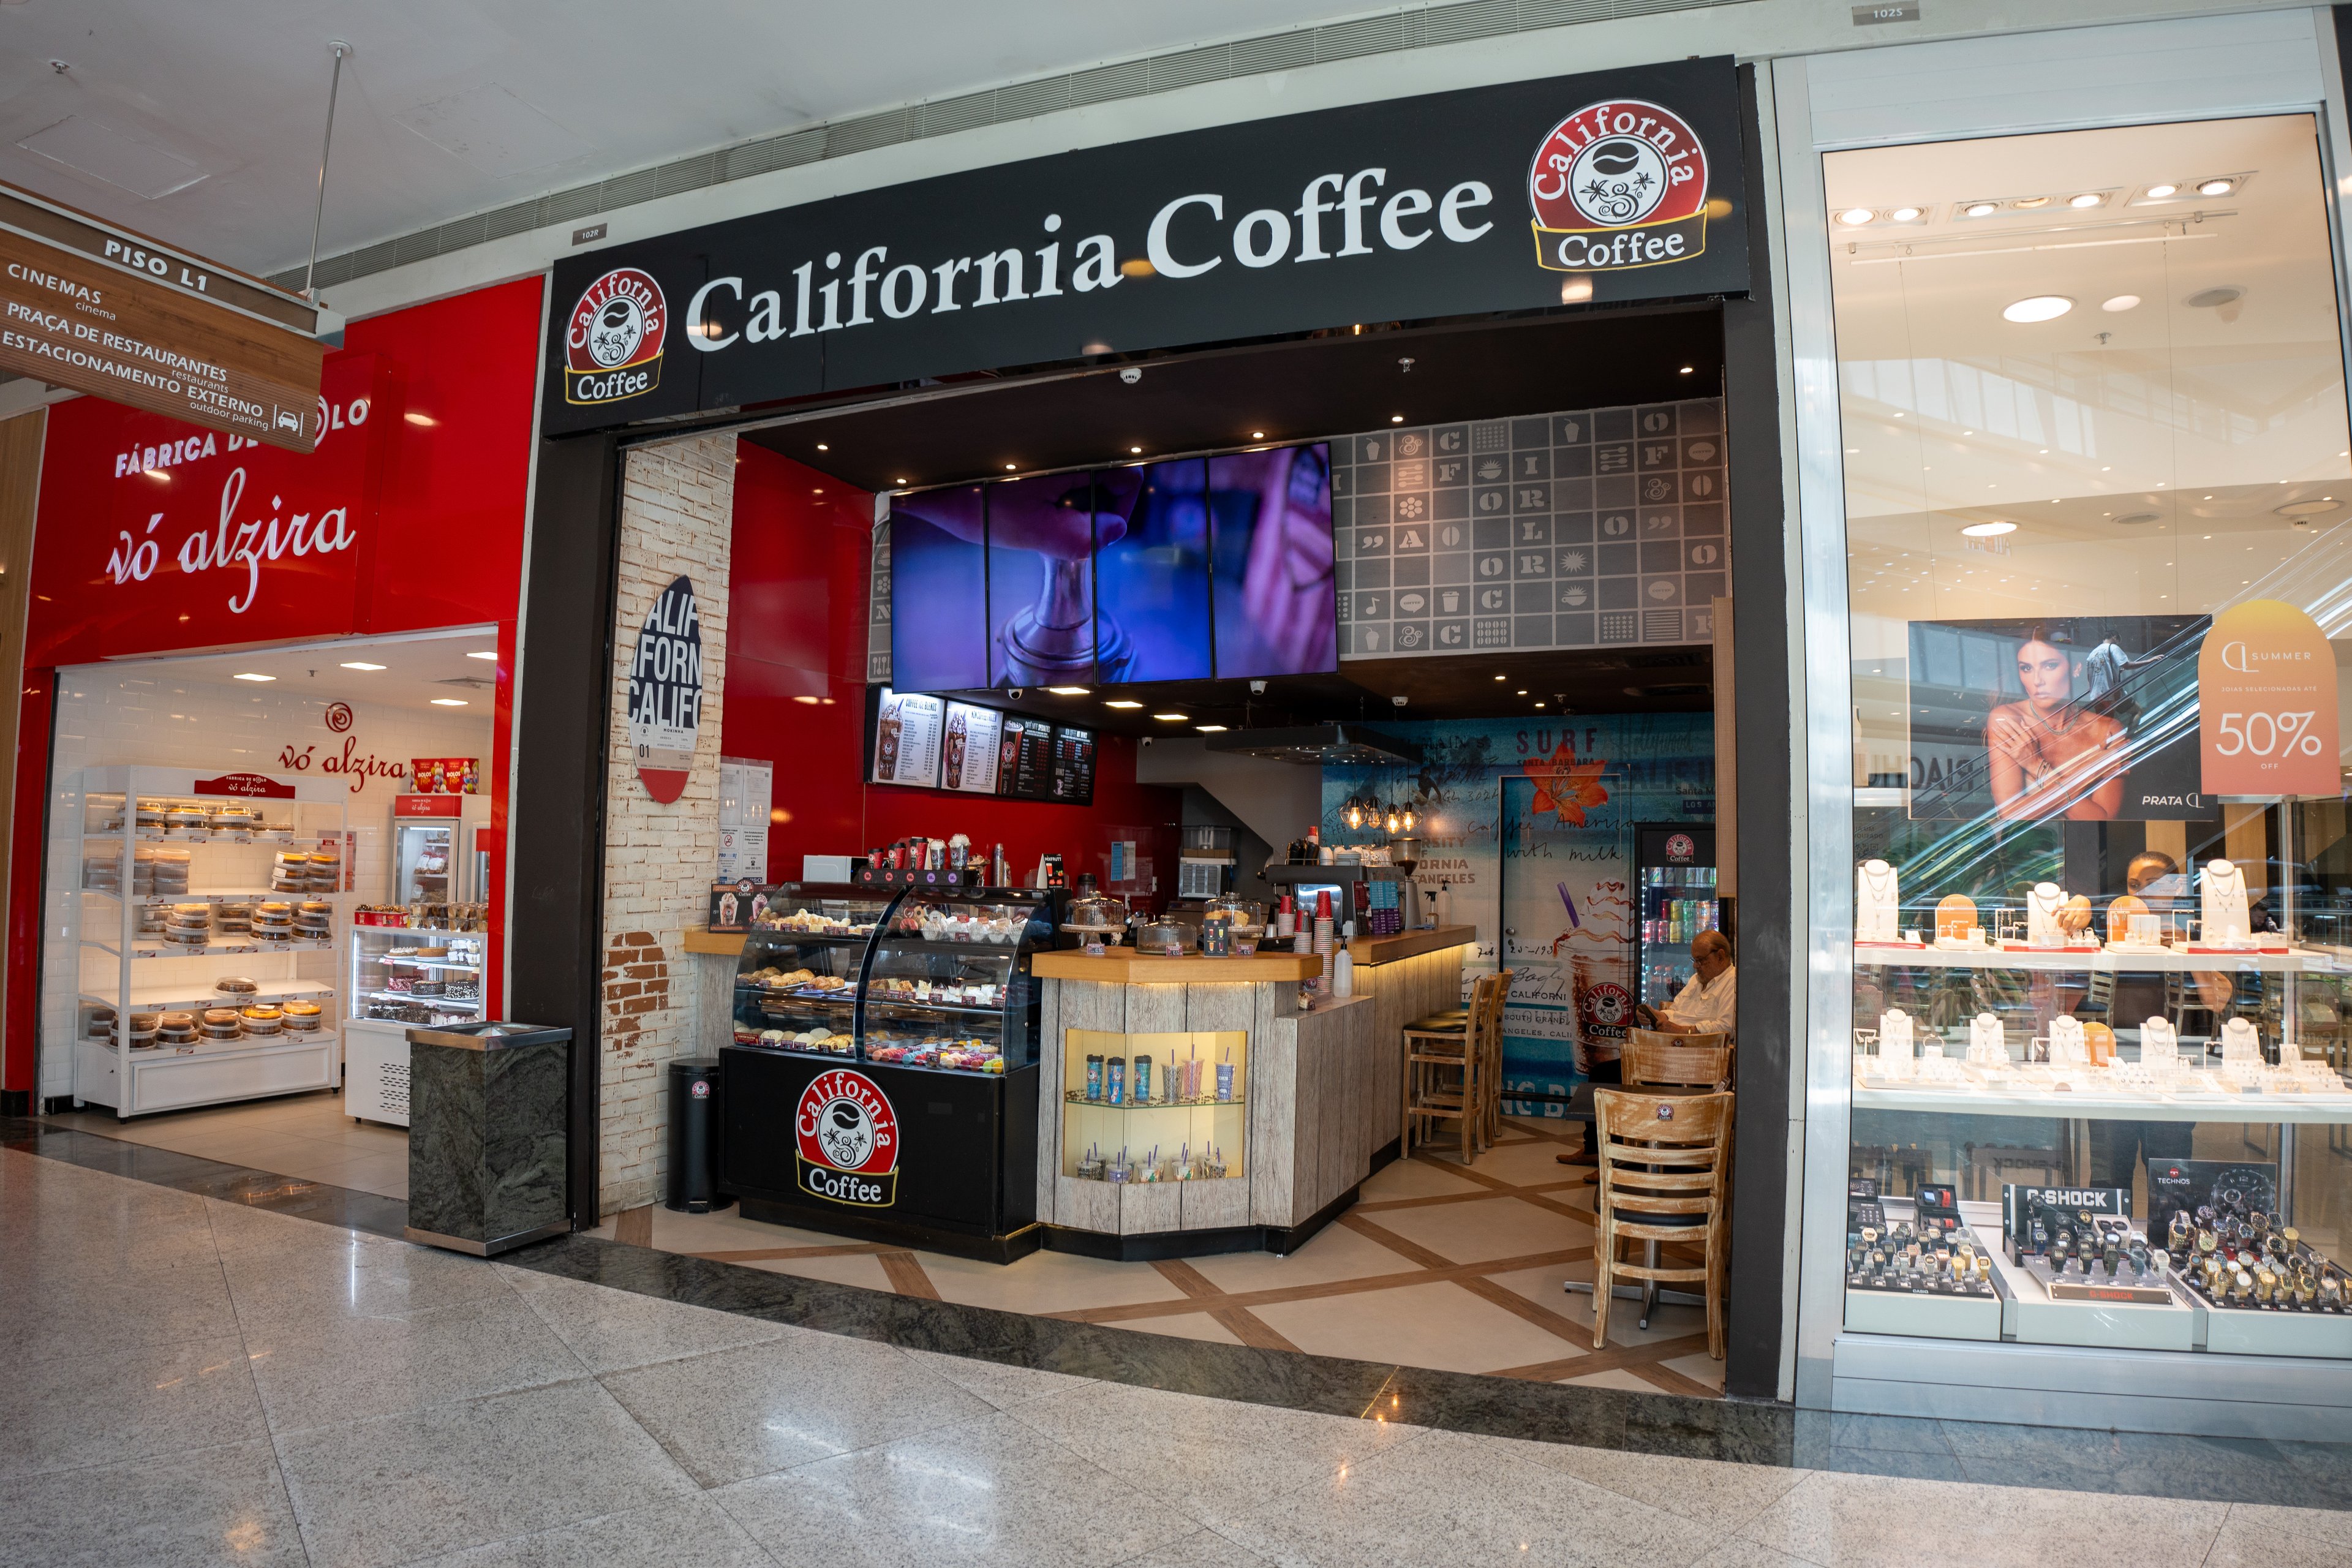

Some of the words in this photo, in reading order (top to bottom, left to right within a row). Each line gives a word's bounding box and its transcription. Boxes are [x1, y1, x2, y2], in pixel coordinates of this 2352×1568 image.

[1534, 107, 1698, 200] California
[582, 229, 599, 239] 102R
[686, 214, 1125, 353] California
[1147, 168, 1494, 279] Coffee
[1558, 232, 1685, 267] Coffee
[105, 239, 167, 276] PISO
[181, 268, 207, 292] L1
[8, 263, 101, 304] CINEMAS
[75, 301, 116, 321] cinema
[569, 274, 663, 349] California
[7, 302, 70, 335] PRAÇA
[75, 323, 99, 343] DE
[102, 333, 227, 382] RESTAURANTES
[2, 331, 181, 394] ESTACIONAMENTO
[187, 385, 263, 418] EXTERNO
[172, 370, 229, 394] restaurants
[577, 371, 648, 399] Coffee
[189, 401, 230, 421] outdoor
[232, 413, 269, 431] parking
[115, 432, 217, 478] FÁBRICA
[106, 513, 164, 585] vó
[177, 467, 356, 614] alzira
[1399, 530, 1424, 549] A
[2252, 652, 2312, 661] SUMMER
[1516, 728, 1598, 754] SURF
[2215, 710, 2322, 758] 50%
[278, 745, 316, 771] vó
[322, 735, 407, 793] alzira
[639, 744, 650, 758] 01
[1551, 758, 1595, 766] BARBARA
[228, 783, 238, 791] vó
[240, 781, 266, 797] alzira
[1675, 787, 1703, 796] Santa
[1706, 787, 1716, 796] M
[2142, 796, 2183, 805] PRATA
[1507, 842, 1553, 859] with
[1569, 845, 1624, 861] milk
[1666, 834, 1692, 851] California
[1583, 984, 1634, 1016] California
[1589, 1024, 1627, 1038] Coffee
[798, 1072, 895, 1149] California
[809, 1168, 881, 1202] Coffee
[2089, 1290, 2134, 1300] G-SHOCK
